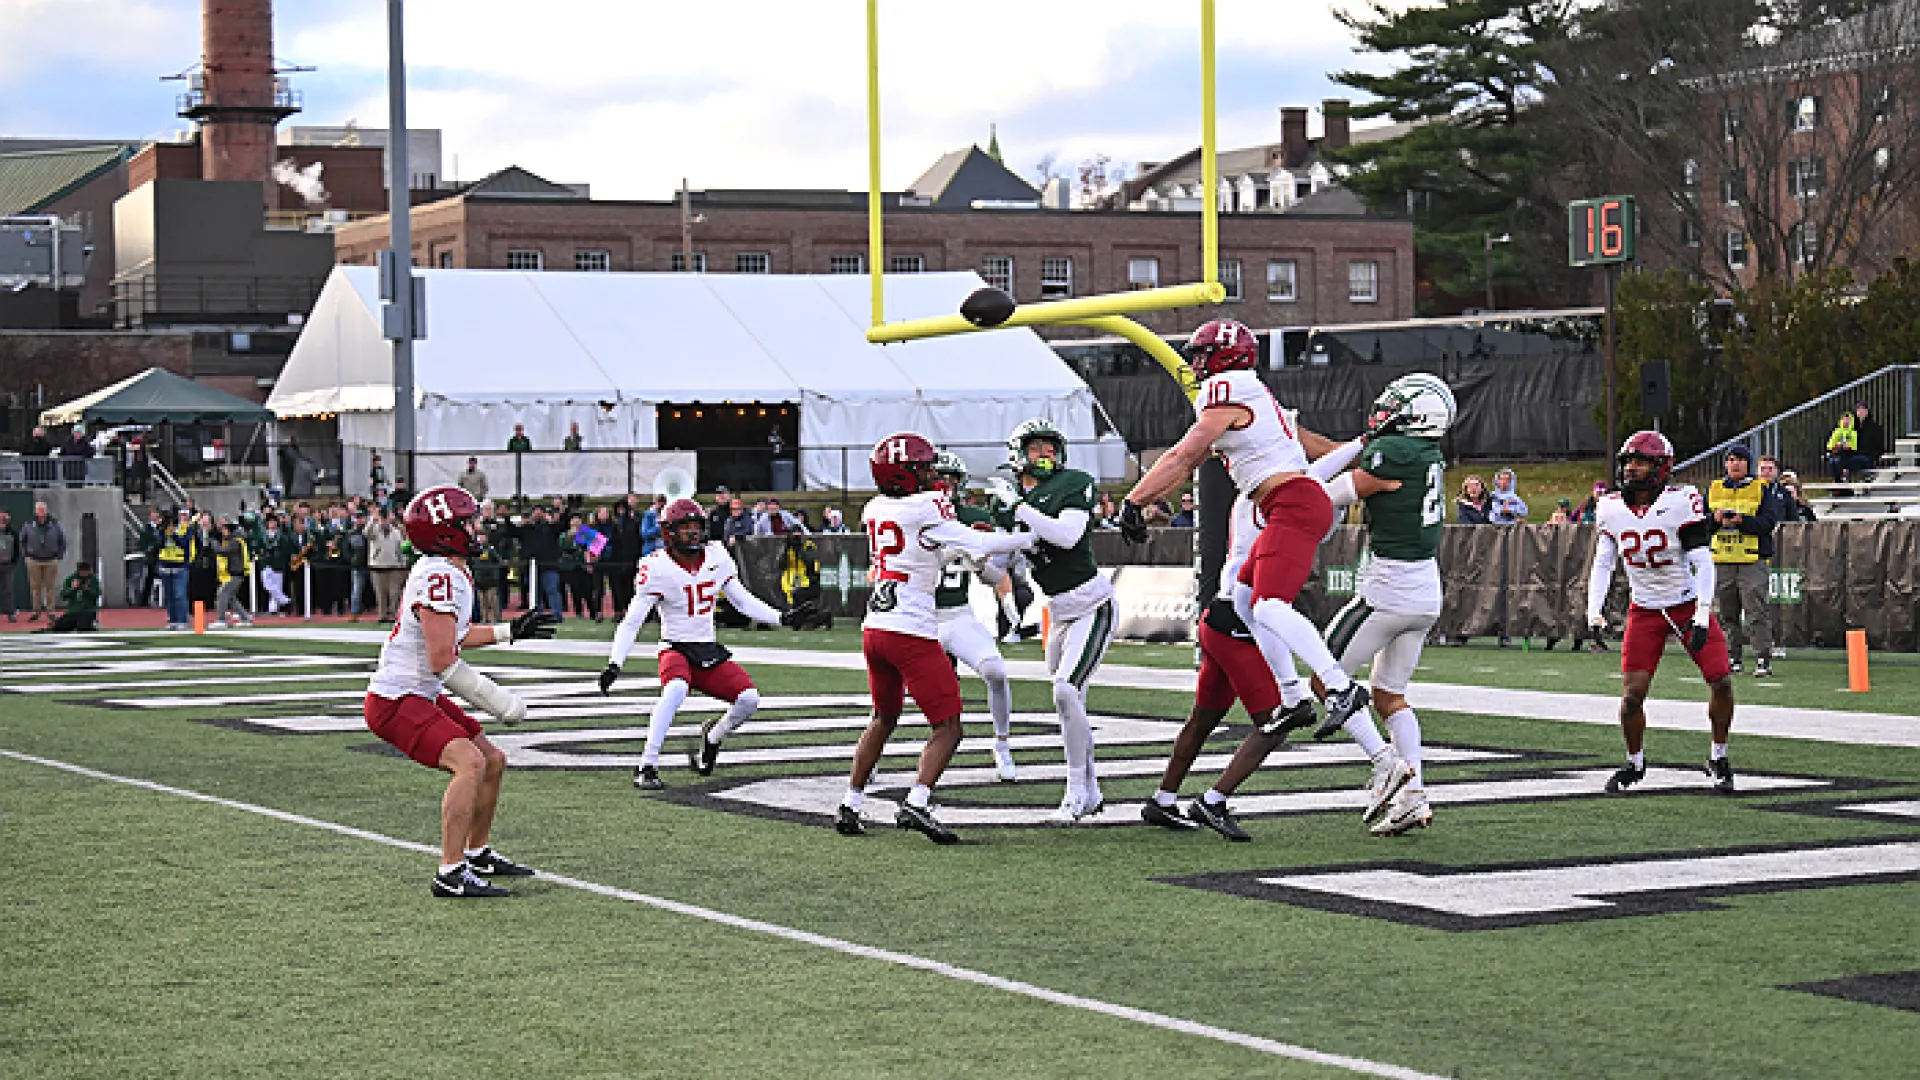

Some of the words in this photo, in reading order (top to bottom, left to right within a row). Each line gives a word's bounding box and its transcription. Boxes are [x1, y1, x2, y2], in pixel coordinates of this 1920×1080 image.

[1588, 202, 1622, 256] 16
[1215, 324, 1238, 348] H
[1209, 381, 1230, 404] 10
[887, 439, 909, 464] H
[424, 493, 454, 524] H
[868, 519, 910, 583] 12
[1620, 530, 1674, 568] 22
[428, 573, 453, 602] 21
[683, 581, 716, 617] 15
